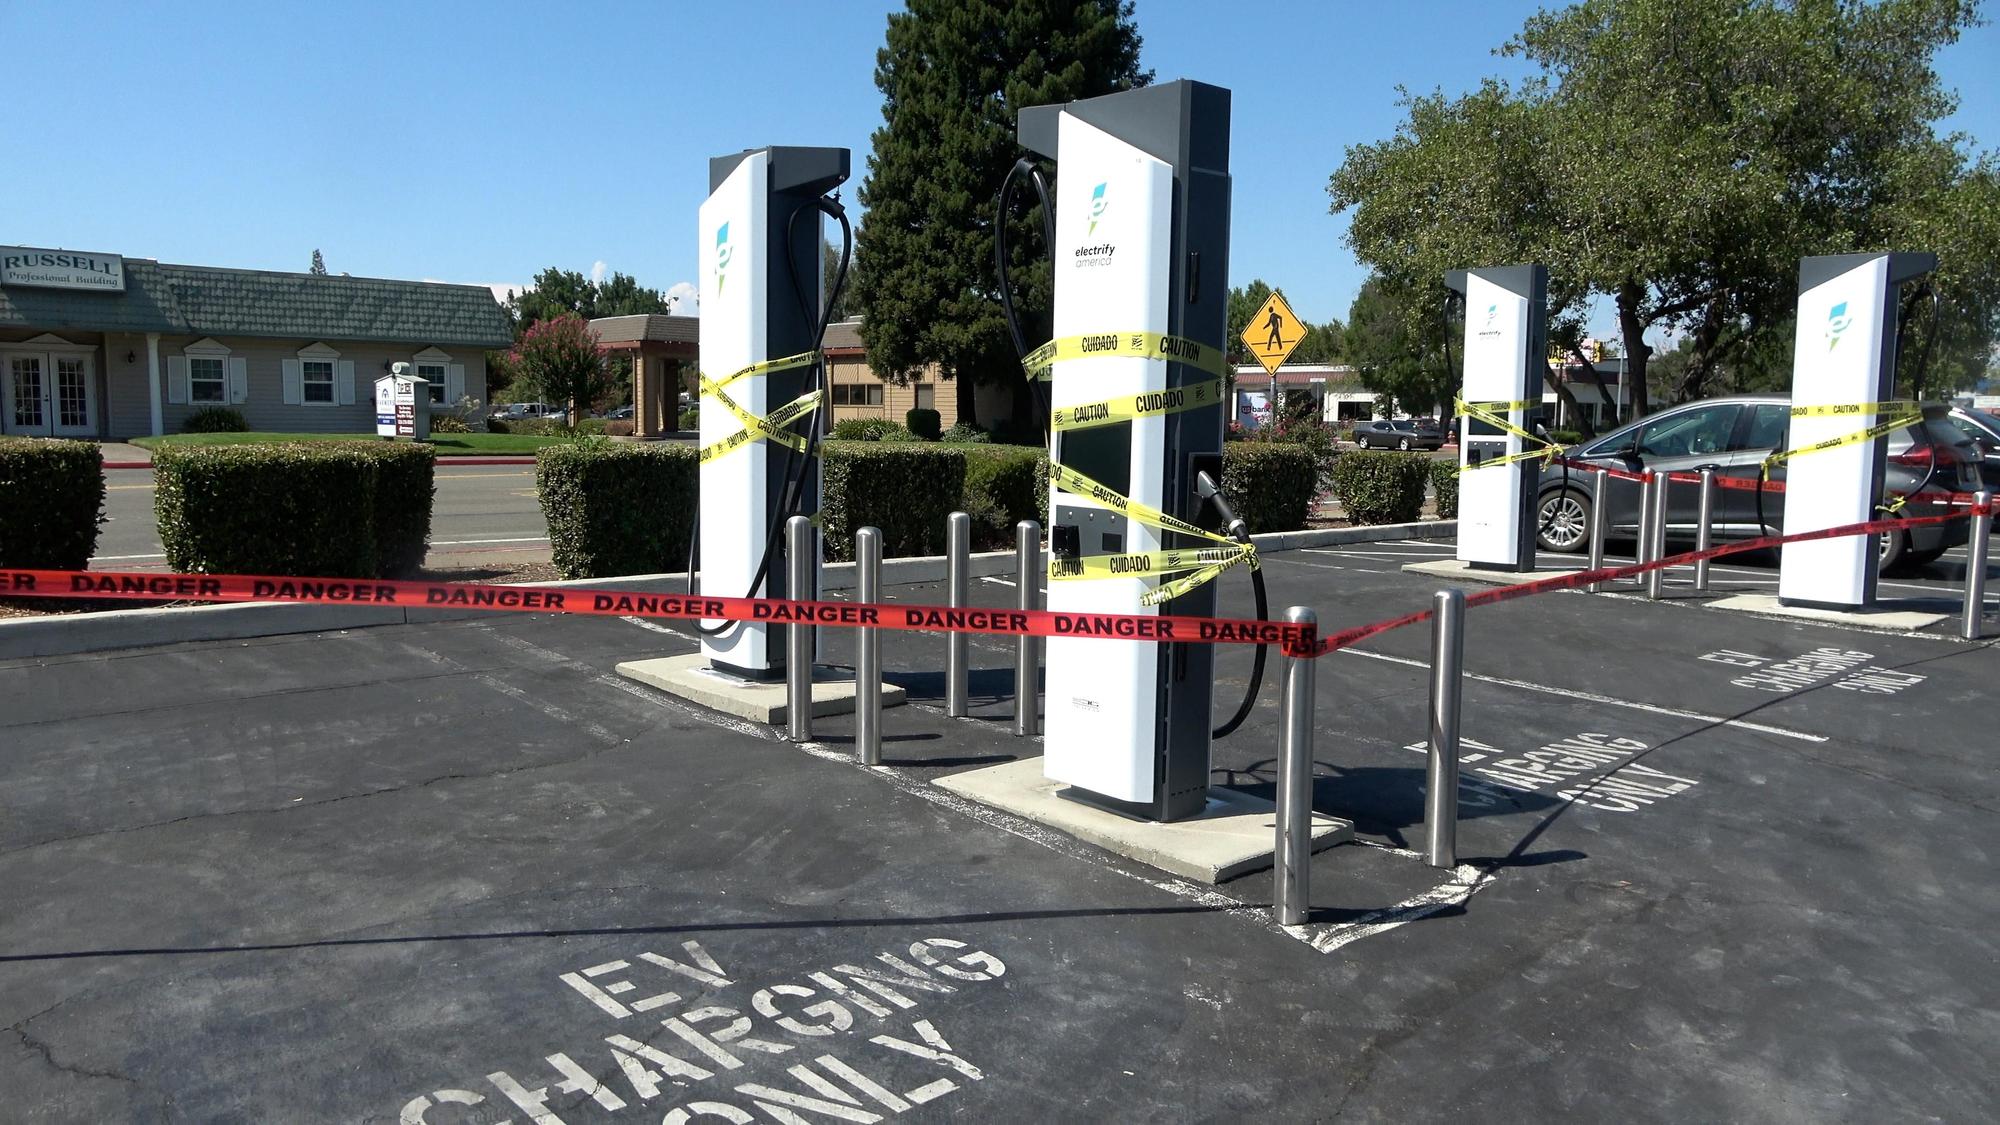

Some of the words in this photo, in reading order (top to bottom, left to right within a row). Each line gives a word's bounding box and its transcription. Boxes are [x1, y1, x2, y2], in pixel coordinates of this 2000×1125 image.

[1075, 244, 1115, 256] electrify
[1076, 257, 1112, 268] america
[4, 254, 119, 277] RUSSELL
[9, 272, 70, 283] Professional
[76, 276, 118, 288] Building
[1082, 334, 1118, 353] CUIDADO
[1160, 337, 1200, 361] CAUTION
[1074, 402, 1109, 424] CAUTION
[1136, 390, 1184, 413] CUIDADO
[1833, 405, 1860, 413] CAUTION
[726, 429, 749, 449] CAUTION
[768, 402, 801, 427] CUIDADO
[757, 420, 791, 442] CAUTION
[1815, 438, 1842, 450] CUIDADO
[1092, 484, 1128, 511] CAUTION
[1052, 560, 1085, 578] CAUTION
[1110, 554, 1151, 574] CUIDADO
[70, 575, 221, 597] DANGER
[253, 580, 398, 602] DANGER
[426, 588, 565, 609] DANGER
[594, 595, 725, 617] DANGER
[752, 603, 879, 625] DANGER
[905, 610, 1029, 632] DANGER
[1054, 615, 1176, 638] DANGER
[1200, 622, 1317, 643] DANGER
[1698, 649, 1771, 667] EV
[1730, 647, 1875, 692] CHARGING
[1833, 666, 1927, 694] ONLY
[1557, 762, 1699, 812] ONLY
[559, 940, 737, 1019] EV
